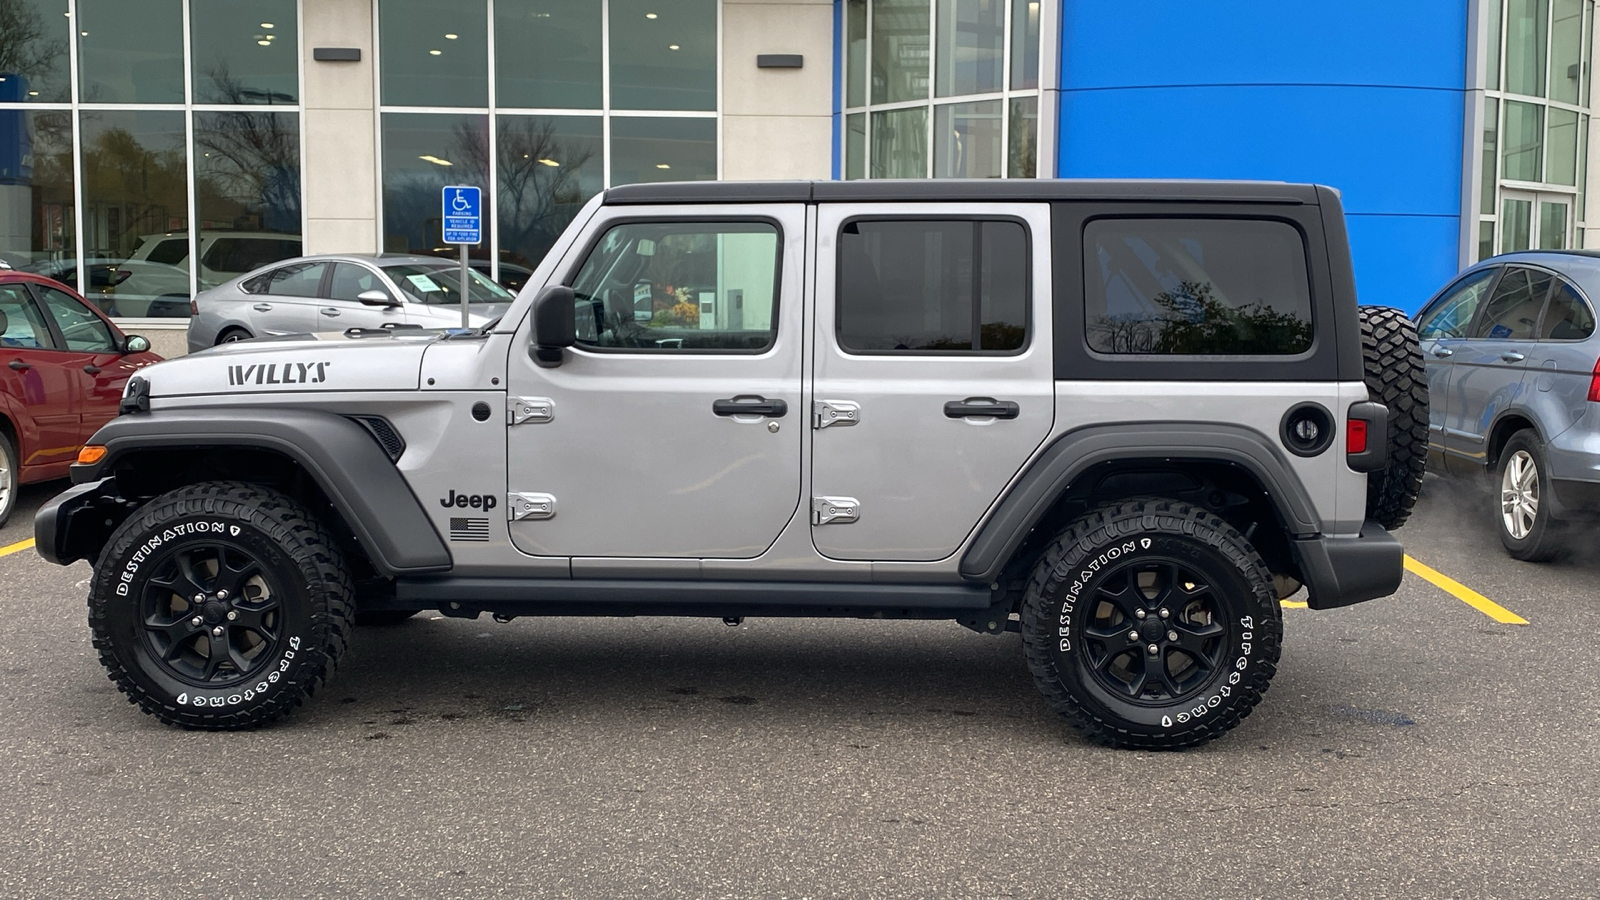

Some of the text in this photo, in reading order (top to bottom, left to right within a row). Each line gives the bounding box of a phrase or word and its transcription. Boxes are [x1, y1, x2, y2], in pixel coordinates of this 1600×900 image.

[228, 362, 331, 386] WILLYS
[440, 489, 497, 512] Jeep
[116, 521, 225, 597] DESTINATION
[1059, 540, 1136, 652] DESTINATION
